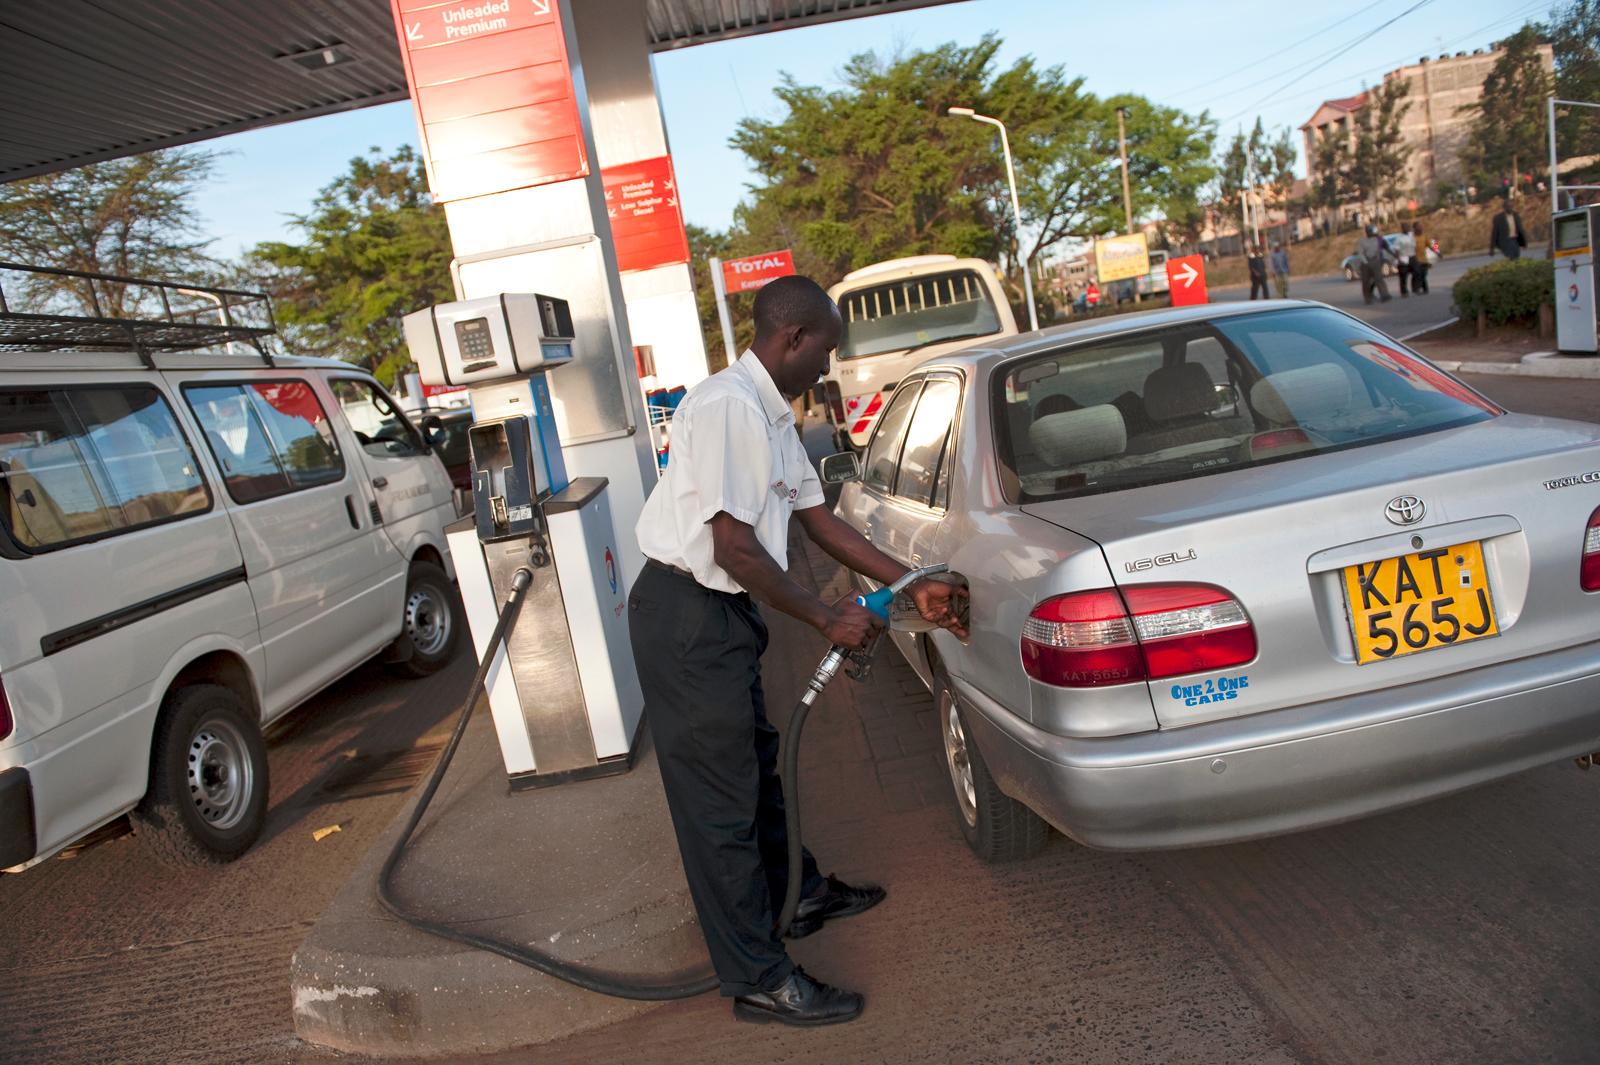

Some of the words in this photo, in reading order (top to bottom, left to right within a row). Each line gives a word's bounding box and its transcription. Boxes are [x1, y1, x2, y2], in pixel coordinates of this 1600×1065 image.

[442, 0, 509, 23] Unleaded
[445, 17, 507, 38] Premium
[731, 257, 784, 274] TOTAL
[1543, 476, 1581, 490] TOYOTA
[1125, 558, 1153, 573] 1.6
[1154, 548, 1197, 566] GLi
[1357, 549, 1448, 609] KAT
[1368, 588, 1491, 658] 565J
[1062, 671, 1088, 681] KAT
[1093, 668, 1129, 680] 565J
[1205, 679, 1215, 694] 2
[1185, 690, 1238, 707] CARS
